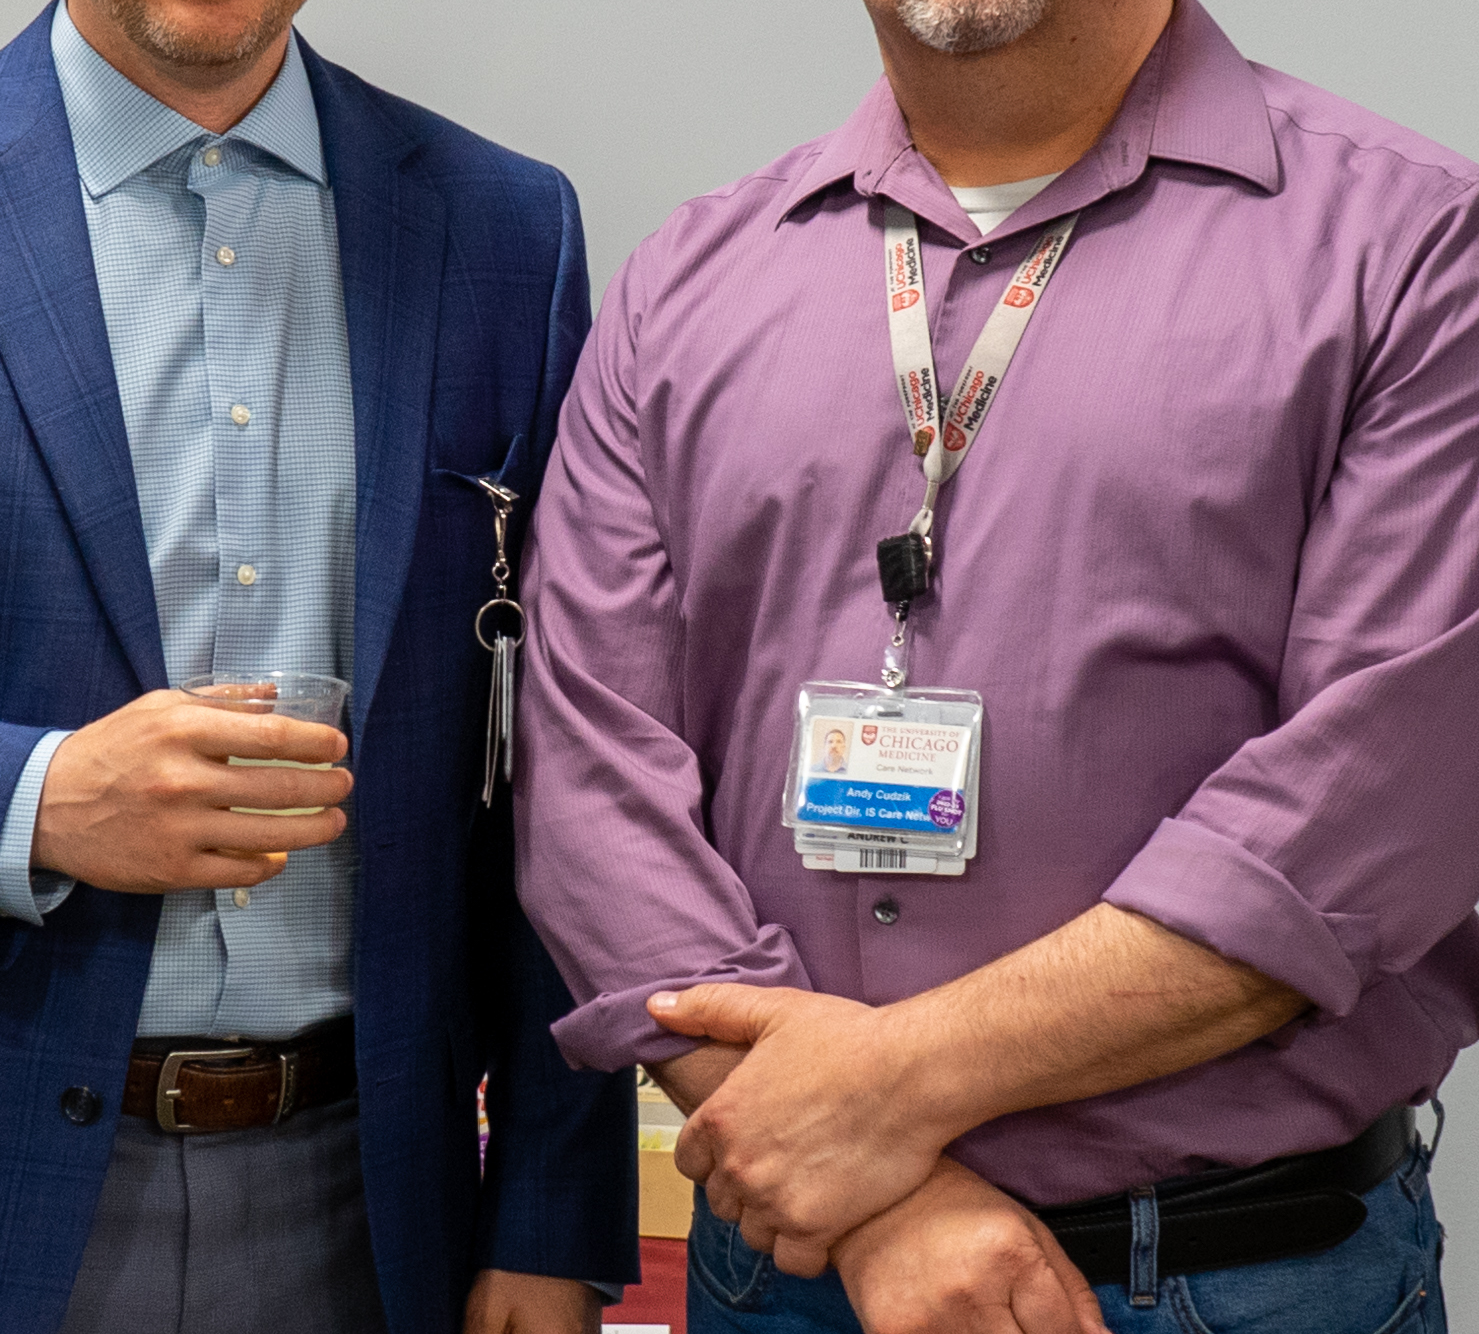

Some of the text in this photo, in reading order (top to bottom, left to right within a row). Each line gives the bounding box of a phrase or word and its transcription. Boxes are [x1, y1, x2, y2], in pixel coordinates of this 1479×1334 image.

[895, 243, 907, 290] UChicago
[905, 237, 919, 286] Medicine
[1021, 234, 1054, 284] UChicago
[1032, 235, 1064, 286] Medicine
[908, 370, 925, 427] UChicago
[920, 368, 935, 422] Medicine
[954, 370, 984, 425] UChicago
[963, 375, 997, 431] Medicine
[879, 734, 959, 753] CHICAGO
[882, 726, 897, 734] THE
[900, 728, 947, 737] UNIVERSITY
[878, 749, 936, 762] MEDICINE
[897, 765, 933, 775] Network
[806, 802, 843, 815] Project
[865, 807, 876, 818] IS
[878, 808, 903, 820] Care
[846, 787, 911, 802] Andy Cudzik
[935, 815, 954, 826] YOU
